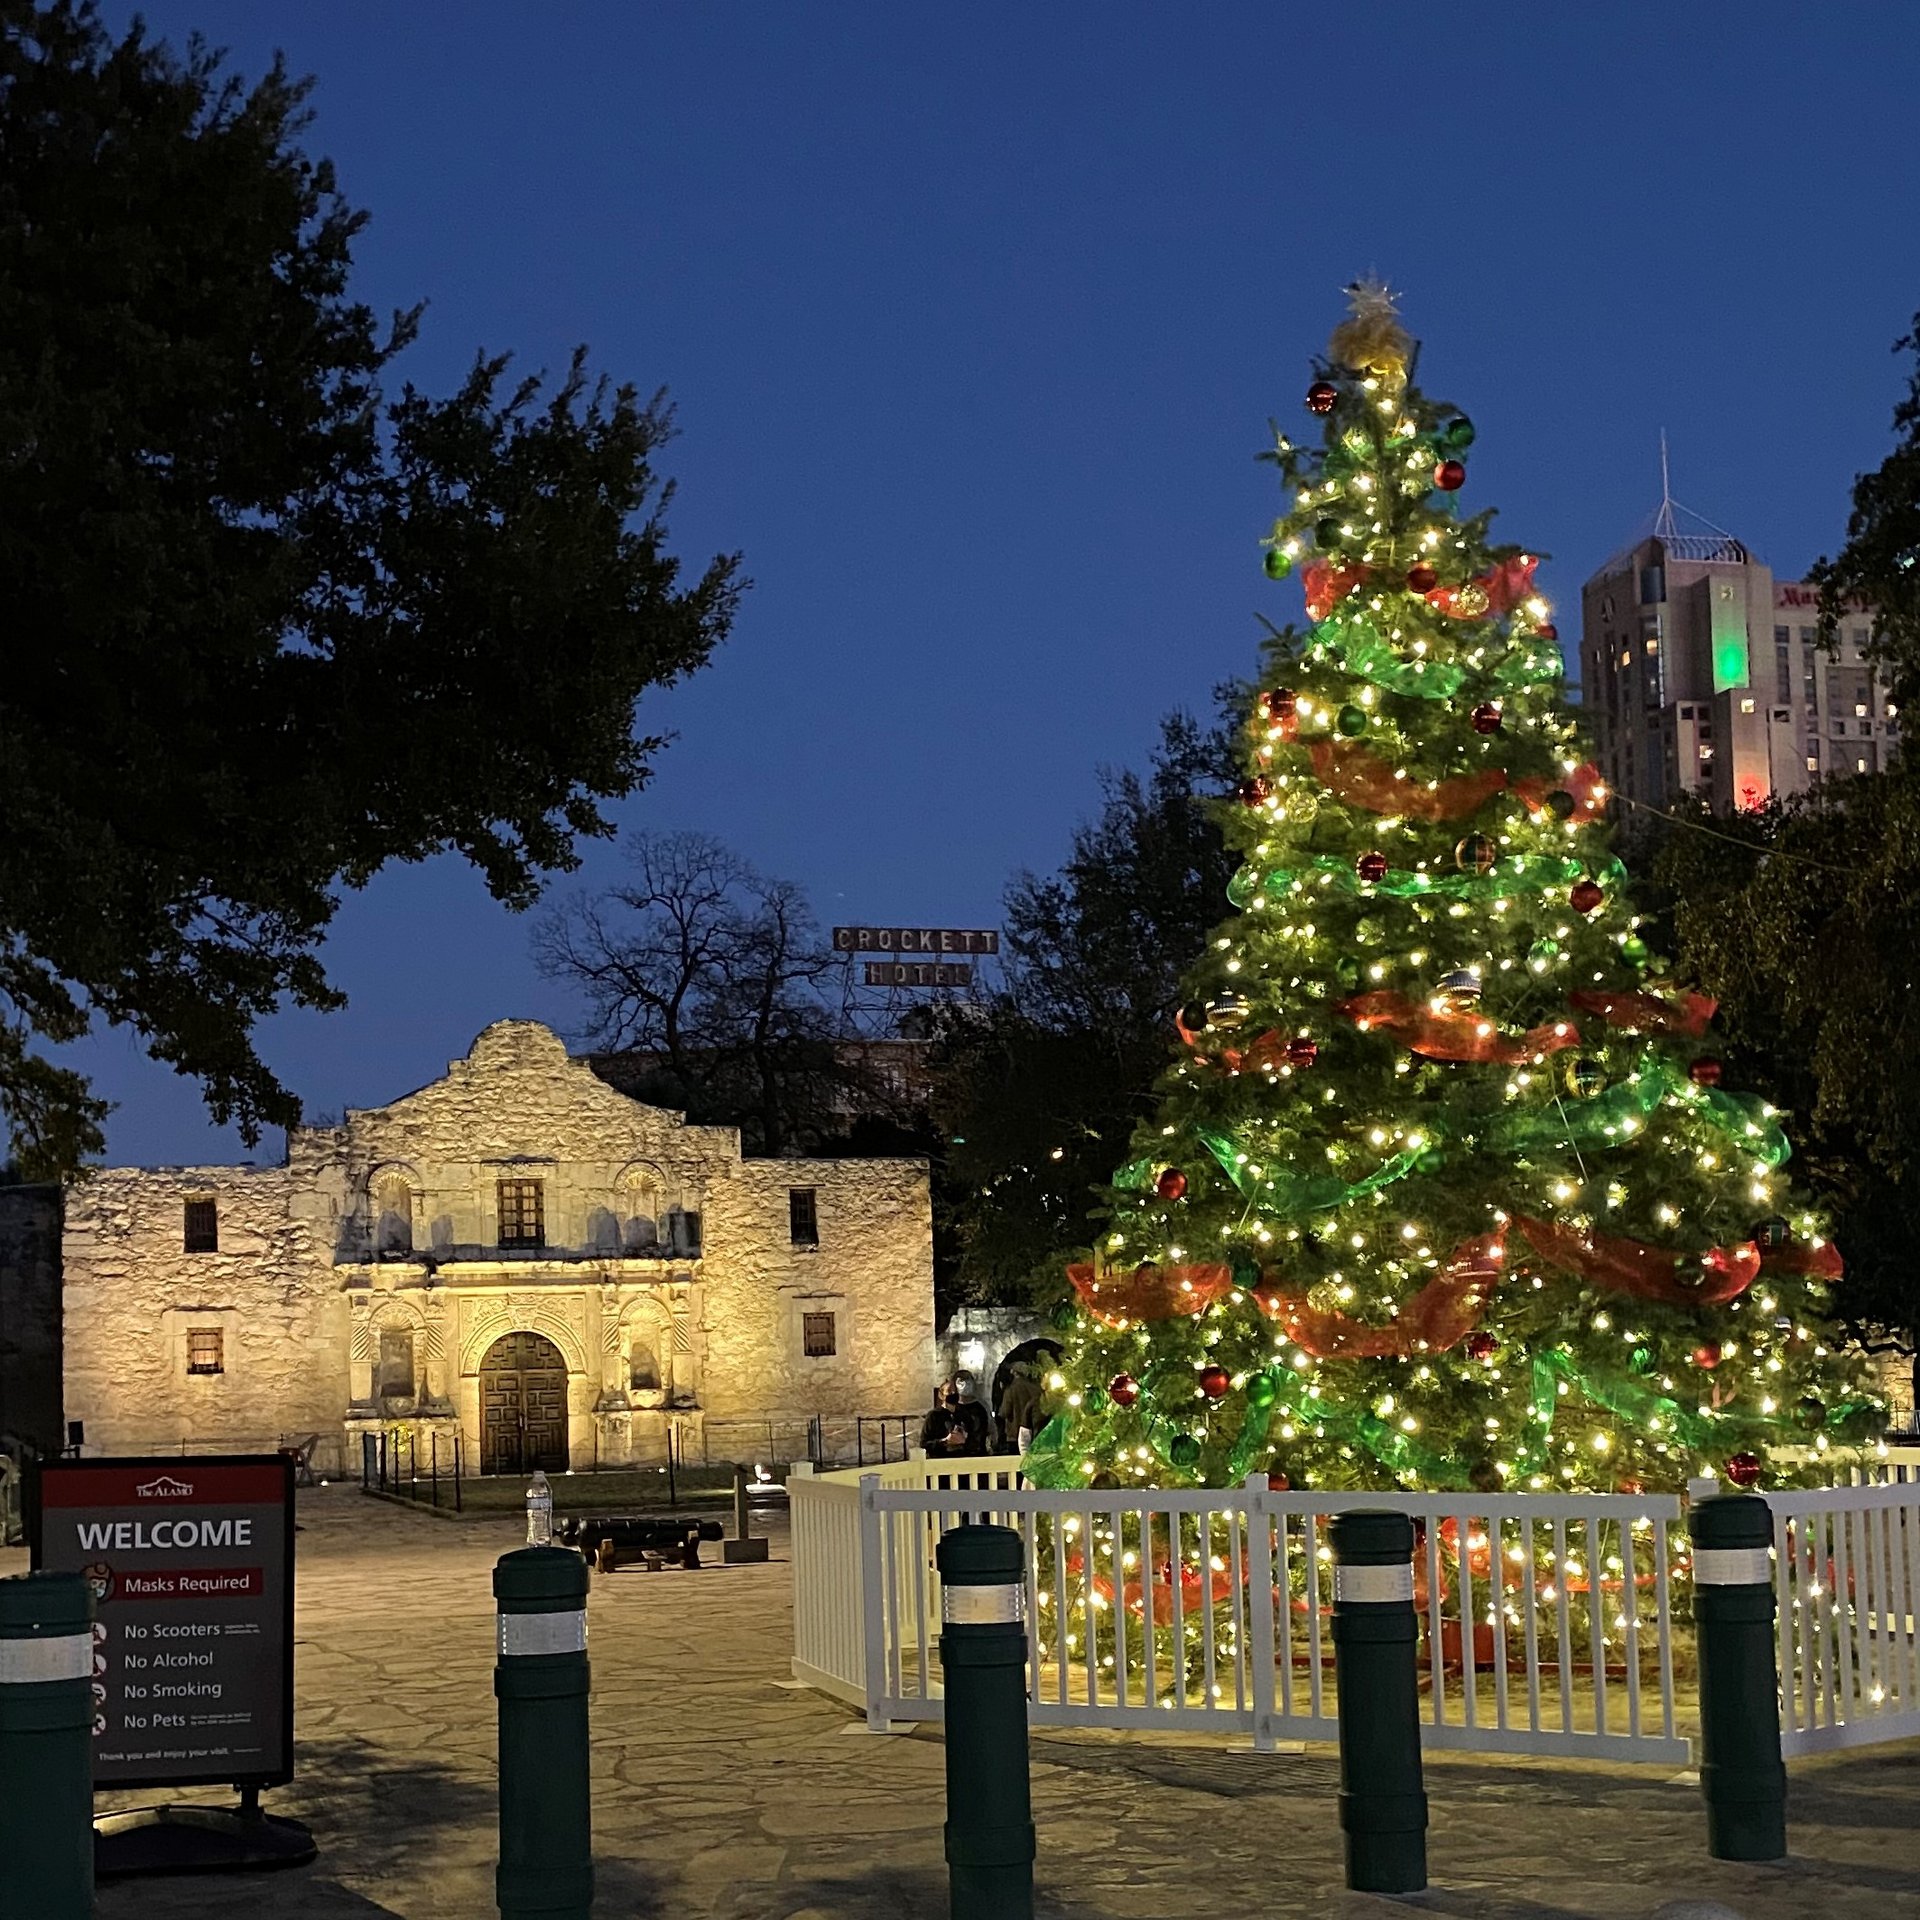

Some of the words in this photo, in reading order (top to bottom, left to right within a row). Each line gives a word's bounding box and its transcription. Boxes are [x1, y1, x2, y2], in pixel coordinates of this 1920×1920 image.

[837, 930, 995, 952] CROCKETT
[869, 964, 967, 985] HOTEL
[136, 1487, 153, 1497] The
[154, 1485, 193, 1497] ALAMO
[76, 1519, 252, 1550] WELCOME
[125, 1577, 175, 1593] Masks
[179, 1574, 250, 1593] Required
[124, 1624, 148, 1639] No
[153, 1623, 221, 1638] Scooters
[124, 1653, 148, 1669] No
[152, 1651, 214, 1668] Alcohol
[124, 1684, 148, 1699] No
[152, 1681, 222, 1699] Smoking
[124, 1714, 148, 1729] No
[152, 1712, 186, 1728] Pets
[99, 1752, 125, 1761] Thank
[126, 1752, 144, 1762] you
[145, 1751, 162, 1760] and
[163, 1750, 187, 1760] enjoy
[188, 1749, 208, 1759] your
